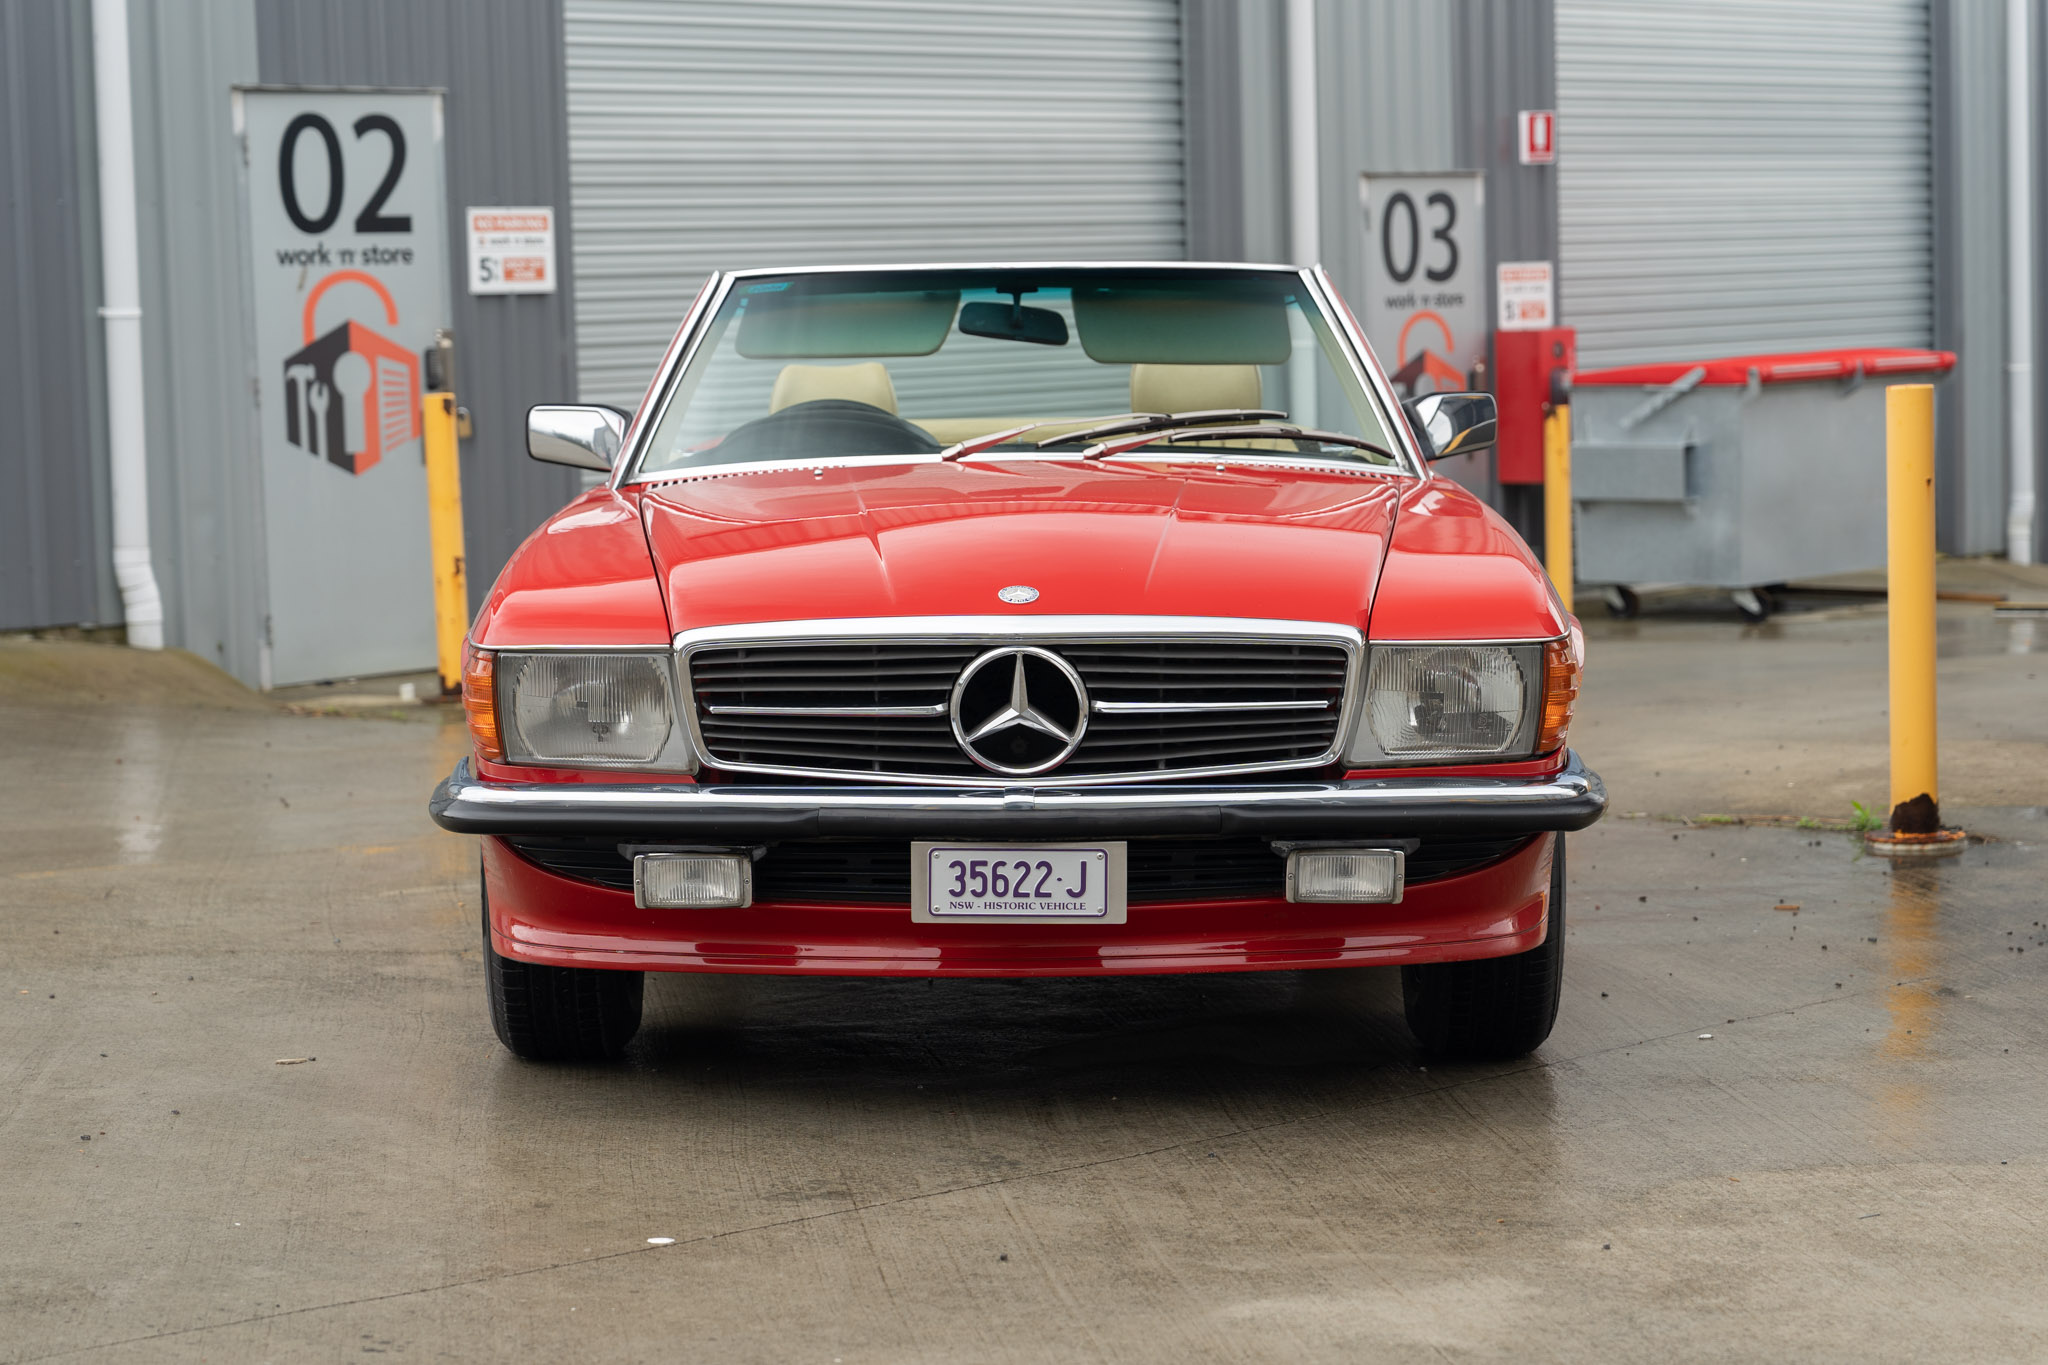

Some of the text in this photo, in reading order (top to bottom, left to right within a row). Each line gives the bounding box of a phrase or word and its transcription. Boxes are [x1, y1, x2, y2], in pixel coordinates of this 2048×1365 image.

[278, 112, 412, 234] 02
[277, 242, 331, 266] work
[362, 244, 414, 266] store
[1383, 191, 1459, 283] 03
[949, 901, 975, 910] NSW
[984, 901, 1037, 911] HISTORIC
[1039, 902, 1087, 911] VEHICLE
